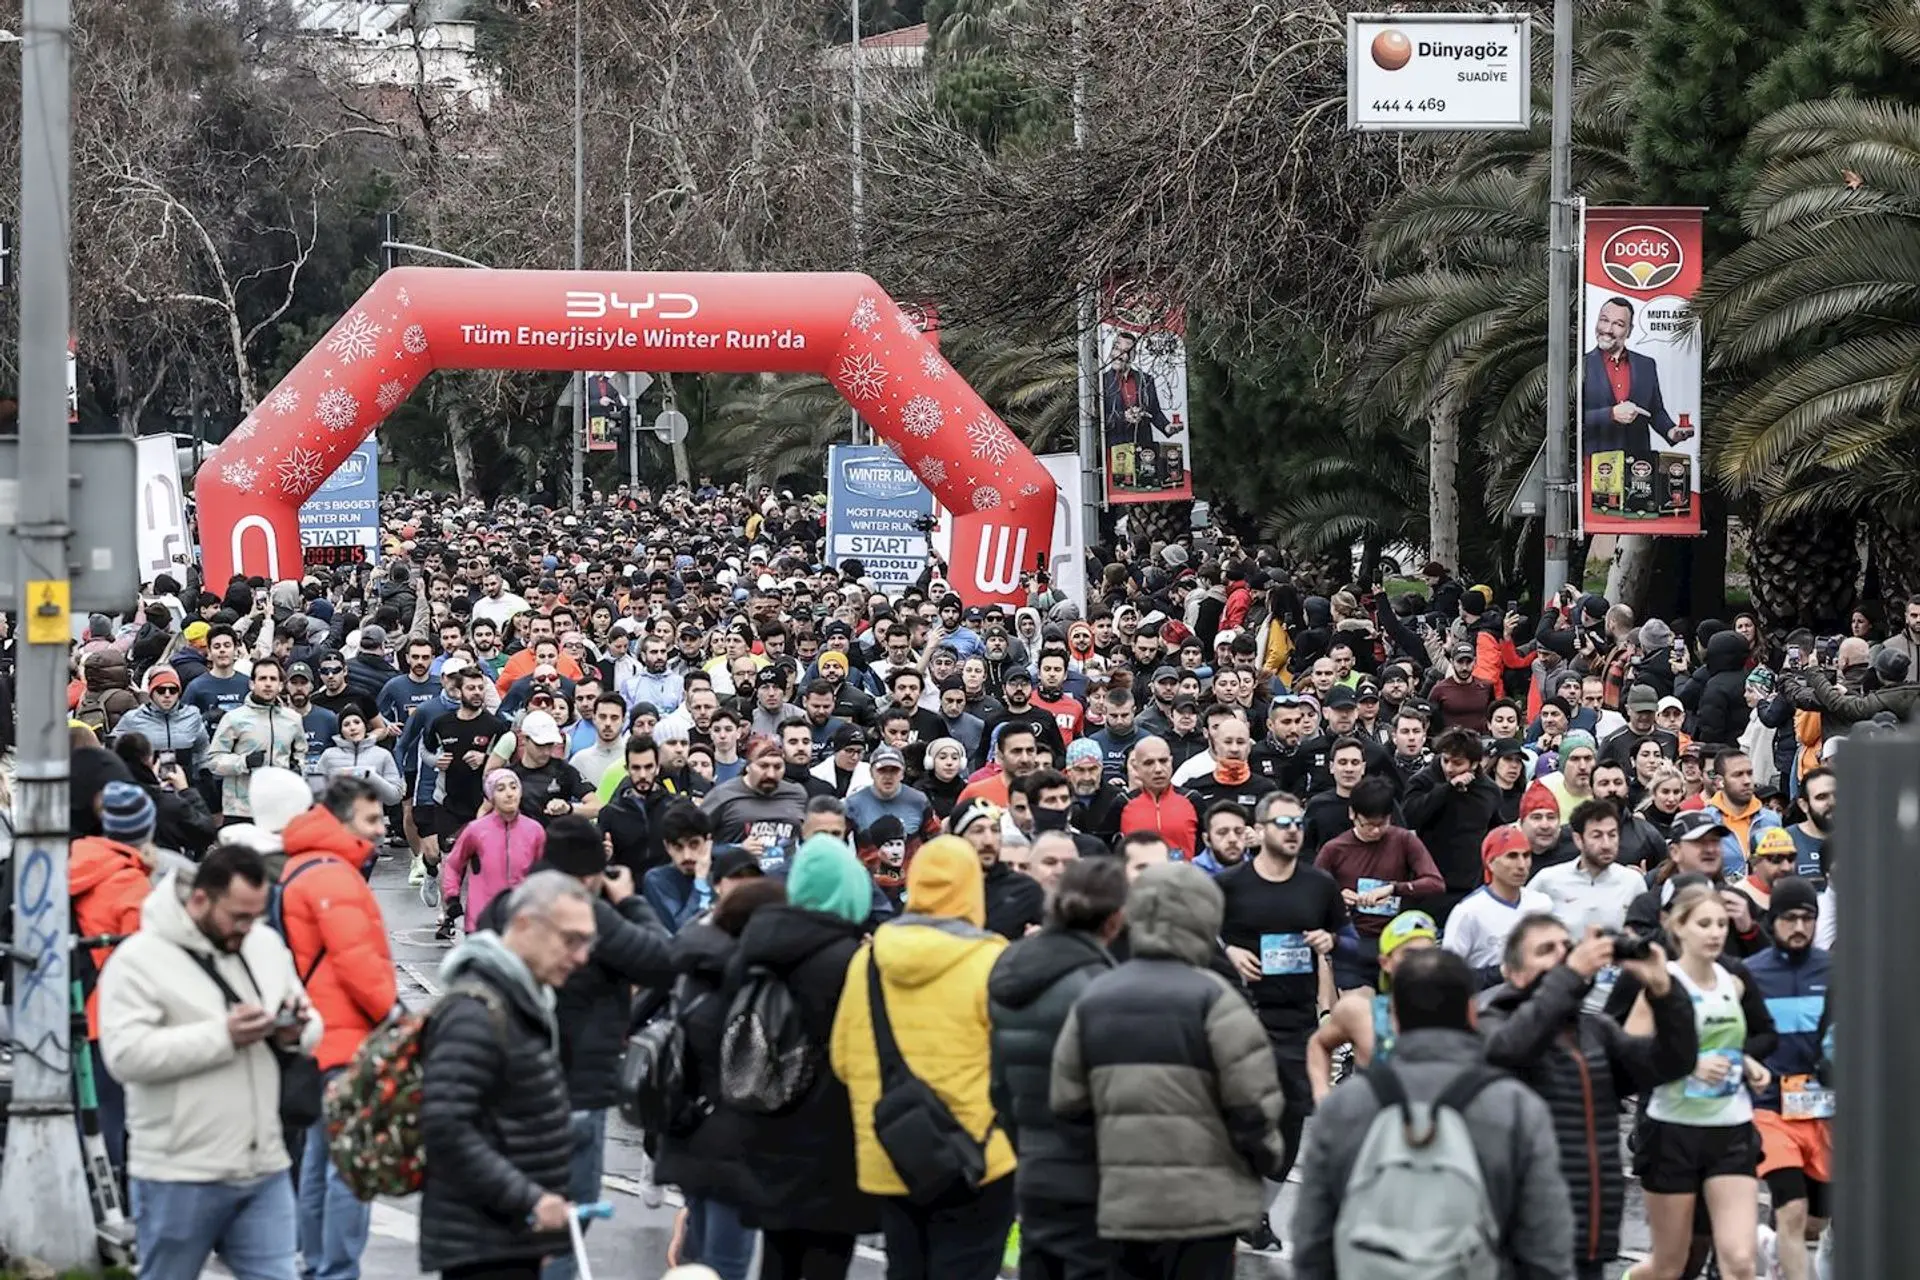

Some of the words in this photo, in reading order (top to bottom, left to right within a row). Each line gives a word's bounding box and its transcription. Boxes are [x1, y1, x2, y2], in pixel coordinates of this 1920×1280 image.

[1418, 42, 1508, 60] Dünyagöz
[1457, 70, 1508, 82] SUADİYE
[1372, 100, 1400, 112] 444
[1404, 100, 1413, 112] 4
[1418, 98, 1446, 112] 469
[1615, 239, 1670, 259] DOĞUŞ
[566, 291, 699, 319] BYD
[1647, 310, 1689, 318] MUTLAK
[460, 324, 511, 345] Tüm
[516, 326, 638, 350] Enerjisiyle
[643, 327, 717, 348] Winter
[848, 468, 892, 483] WINTER
[893, 469, 917, 483] RUN
[299, 501, 331, 511] OPE'S
[332, 500, 377, 510] BIGGEST
[298, 513, 337, 523] WINTER
[339, 513, 361, 522] RUN
[846, 507, 875, 518] MOST
[876, 508, 918, 519] FAMOUS
[850, 521, 890, 531] WINTER
[891, 522, 913, 531] RUN
[300, 530, 360, 546] START
[851, 537, 912, 554] START
[864, 559, 918, 569] NADOLU
